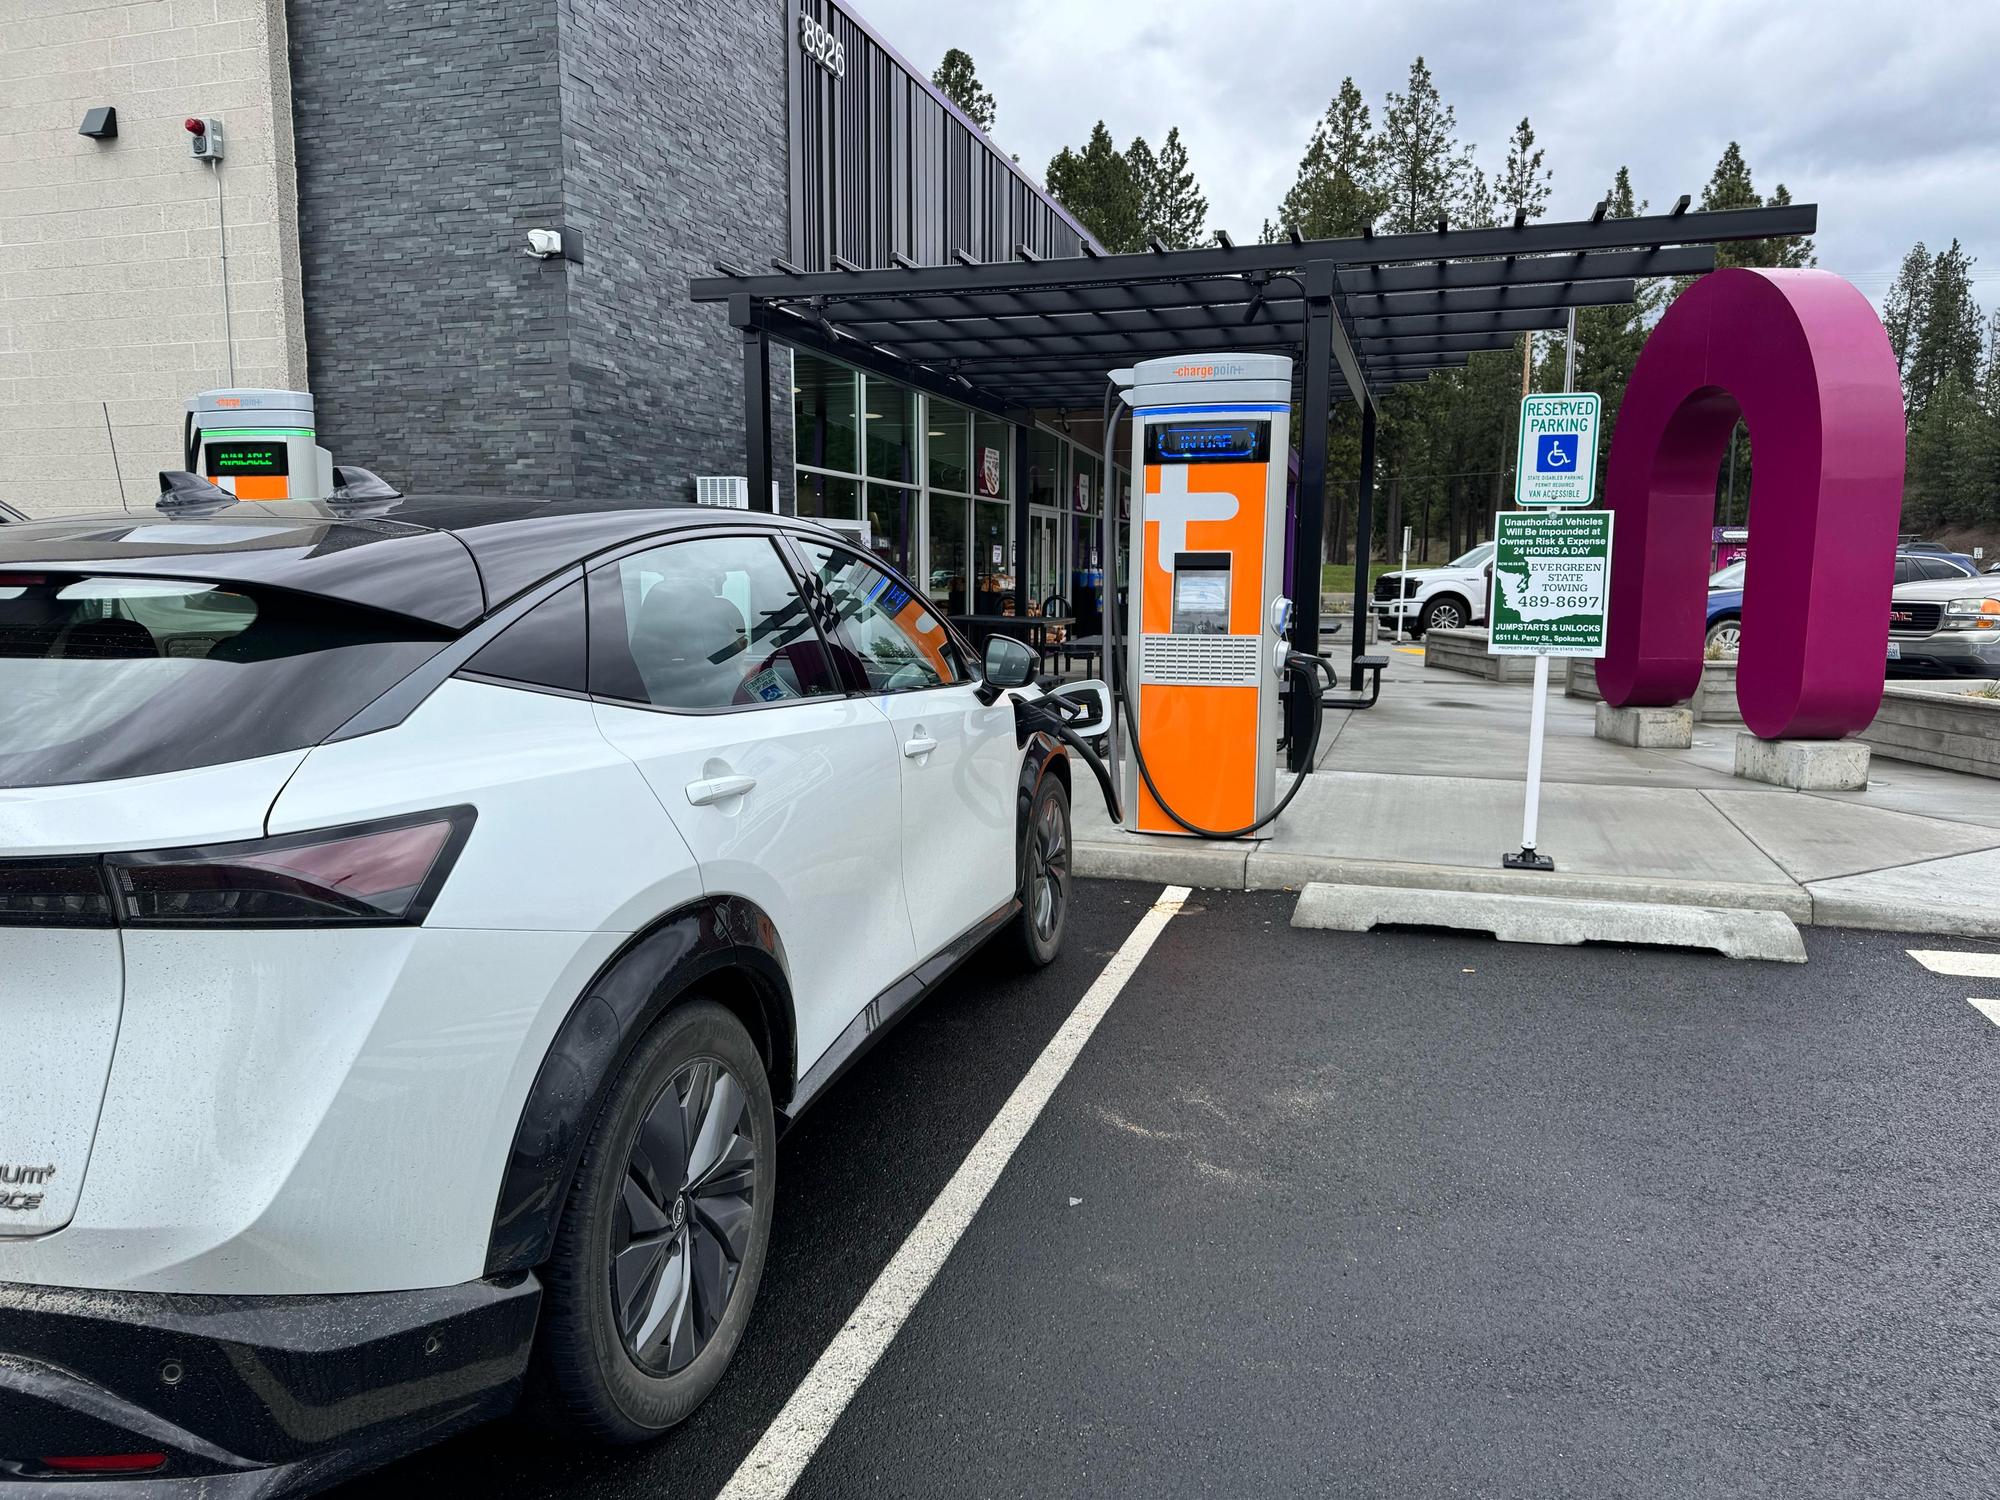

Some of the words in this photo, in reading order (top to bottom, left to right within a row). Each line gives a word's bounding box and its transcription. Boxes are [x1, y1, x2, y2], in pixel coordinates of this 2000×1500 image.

[804, 15, 845, 77] 8926
[1528, 402, 1593, 416] RESERVED
[1531, 418, 1588, 432] PARKING
[1540, 528, 1590, 536] Impounded
[1567, 538, 1606, 546] Expense
[1531, 564, 1602, 572] EVERGREEN
[1542, 584, 1588, 592] TOWING
[1518, 596, 1599, 608] 489-8697
